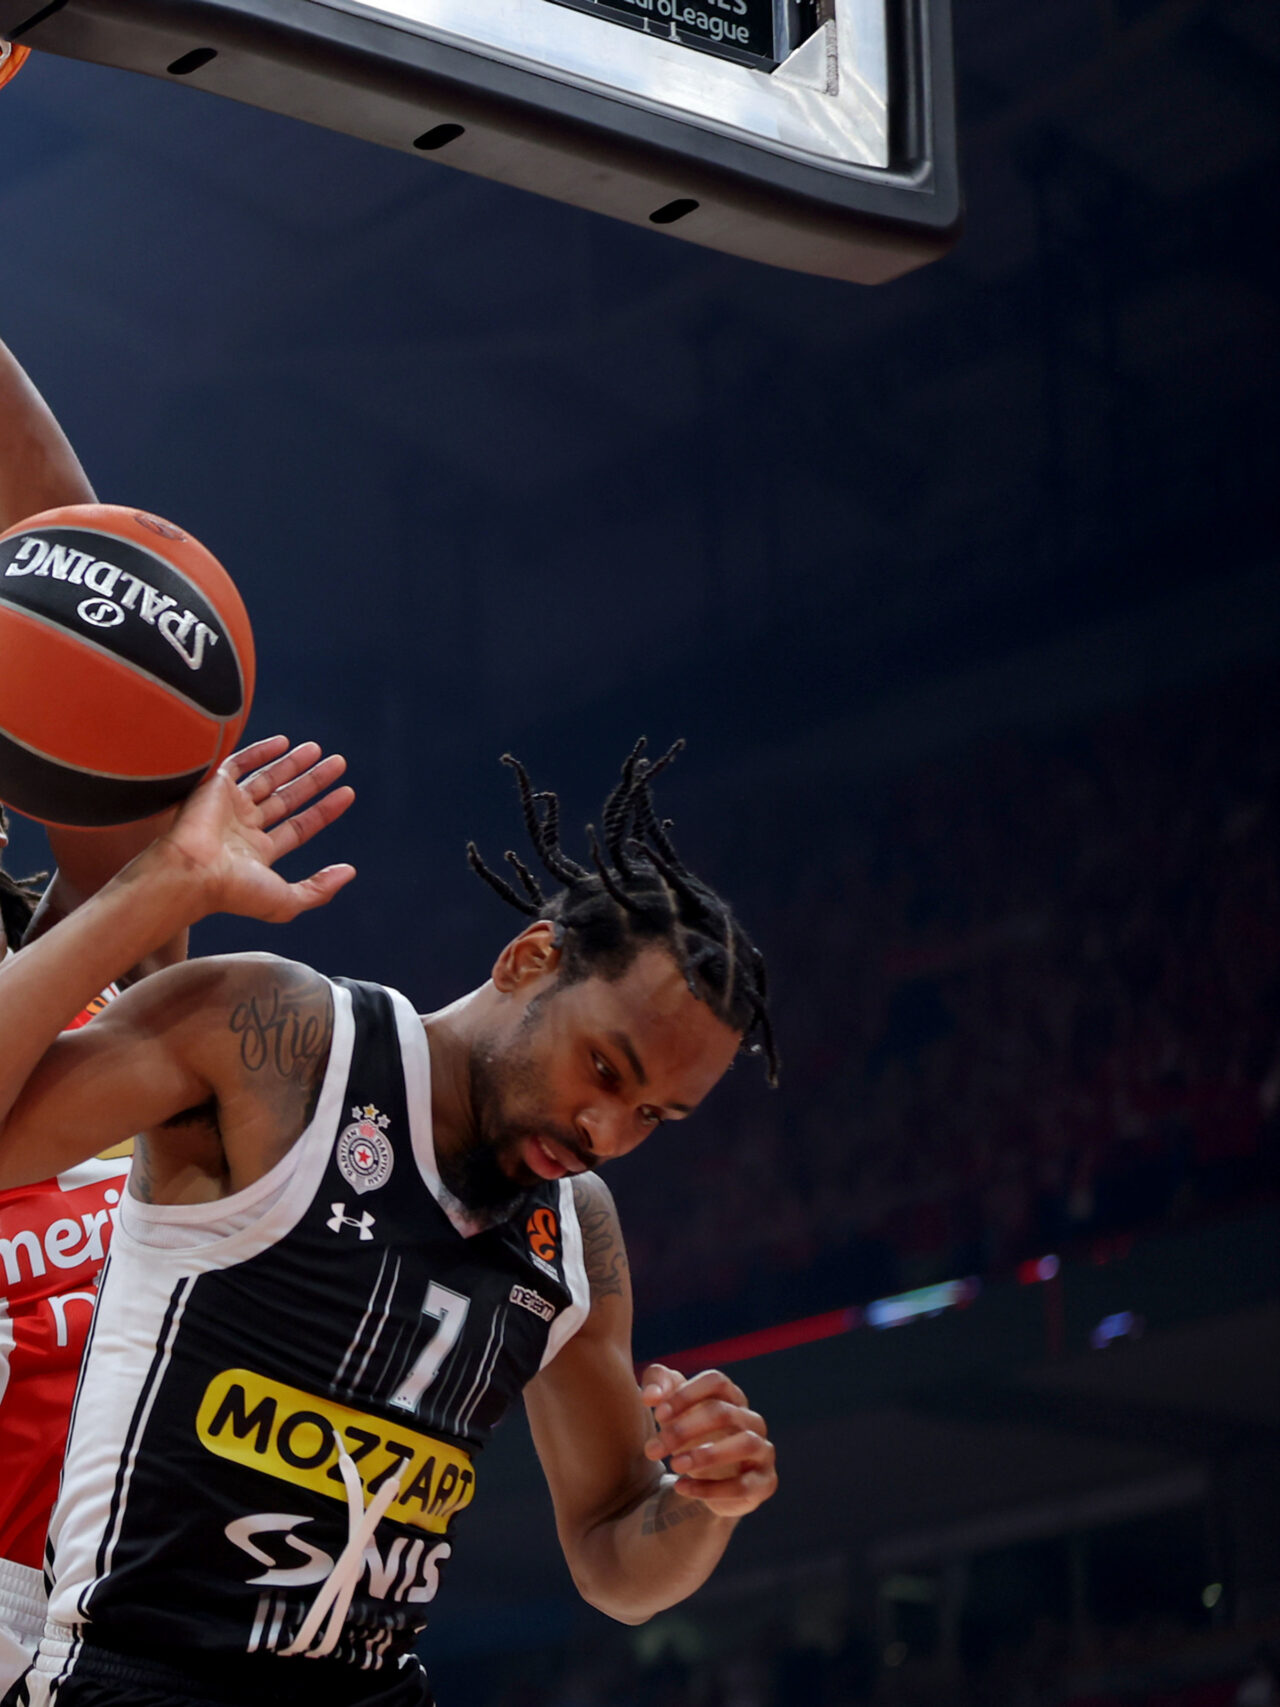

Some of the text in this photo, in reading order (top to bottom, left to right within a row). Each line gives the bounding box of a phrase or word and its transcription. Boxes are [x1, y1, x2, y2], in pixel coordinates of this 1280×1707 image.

[5, 536, 219, 670] SPALDING
[388, 1280, 471, 1413] 7
[207, 1384, 474, 1517] MOZZART
